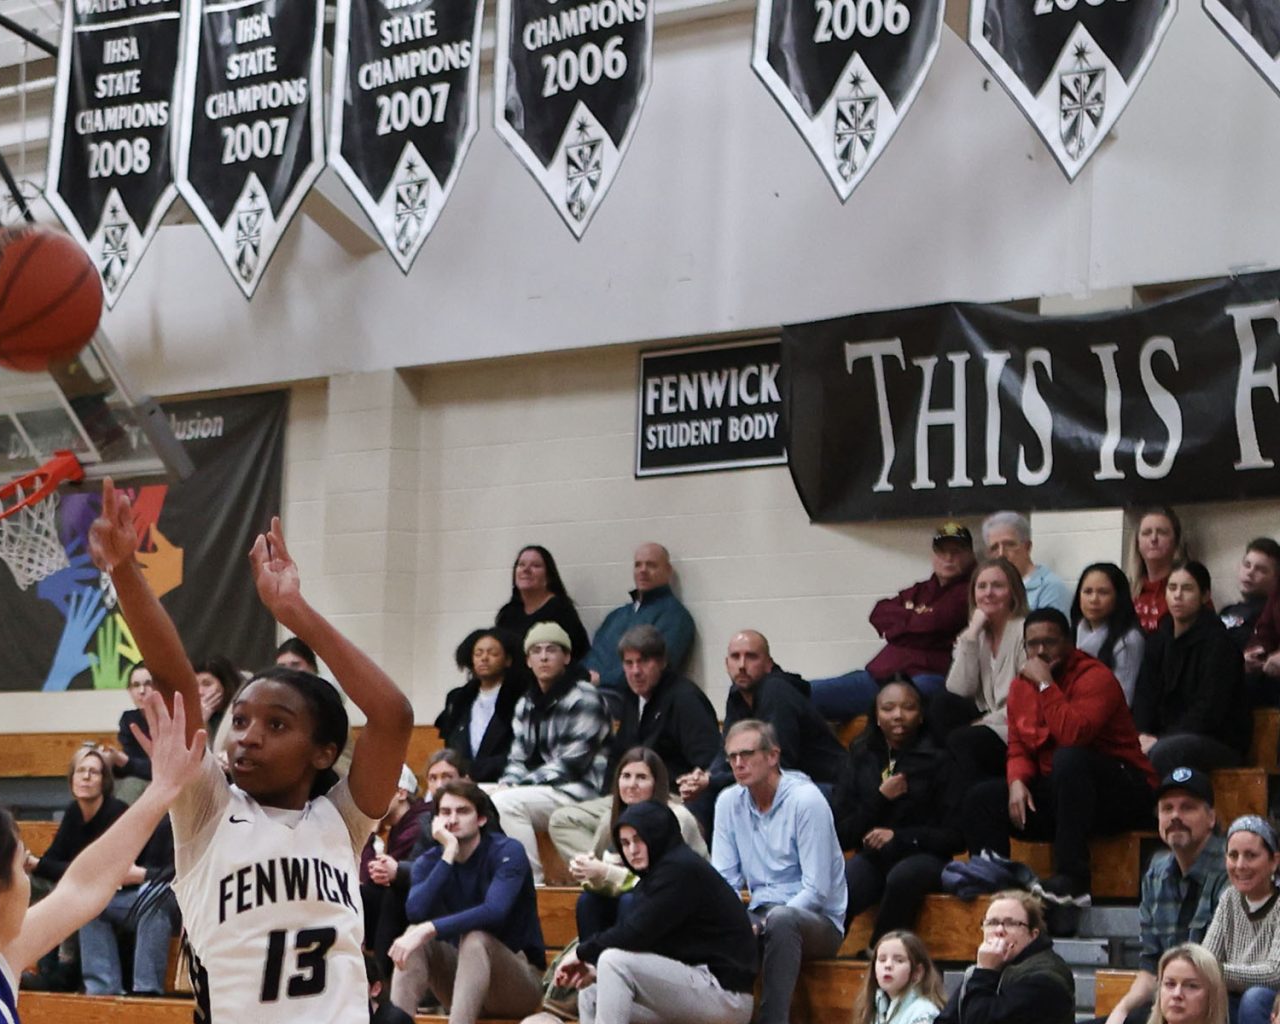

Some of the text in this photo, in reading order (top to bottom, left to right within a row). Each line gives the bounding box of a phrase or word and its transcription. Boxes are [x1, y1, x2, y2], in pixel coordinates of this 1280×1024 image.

[235, 12, 271, 44] IHSA
[380, 10, 437, 47] STATE
[523, 0, 646, 51] CHAMPIONS
[814, 0, 910, 43] 2006
[103, 37, 140, 64] IHSA
[225, 46, 277, 80] STATE
[358, 40, 471, 90] CHAMPIONS
[541, 35, 627, 97] 2006
[95, 69, 141, 98] STATE
[205, 77, 308, 119] CHAMPIONS
[75, 101, 169, 135] CHAMPIONS
[376, 82, 450, 136] 2007
[88, 137, 151, 178] 2008
[221, 117, 289, 164] 2007
[646, 363, 781, 415] FENWICK
[646, 412, 779, 450] STUDENT BODY
[844, 337, 1053, 492] THIS
[1090, 335, 1183, 480] IS
[219, 856, 359, 924] FENWICK
[259, 926, 336, 1004] 13
